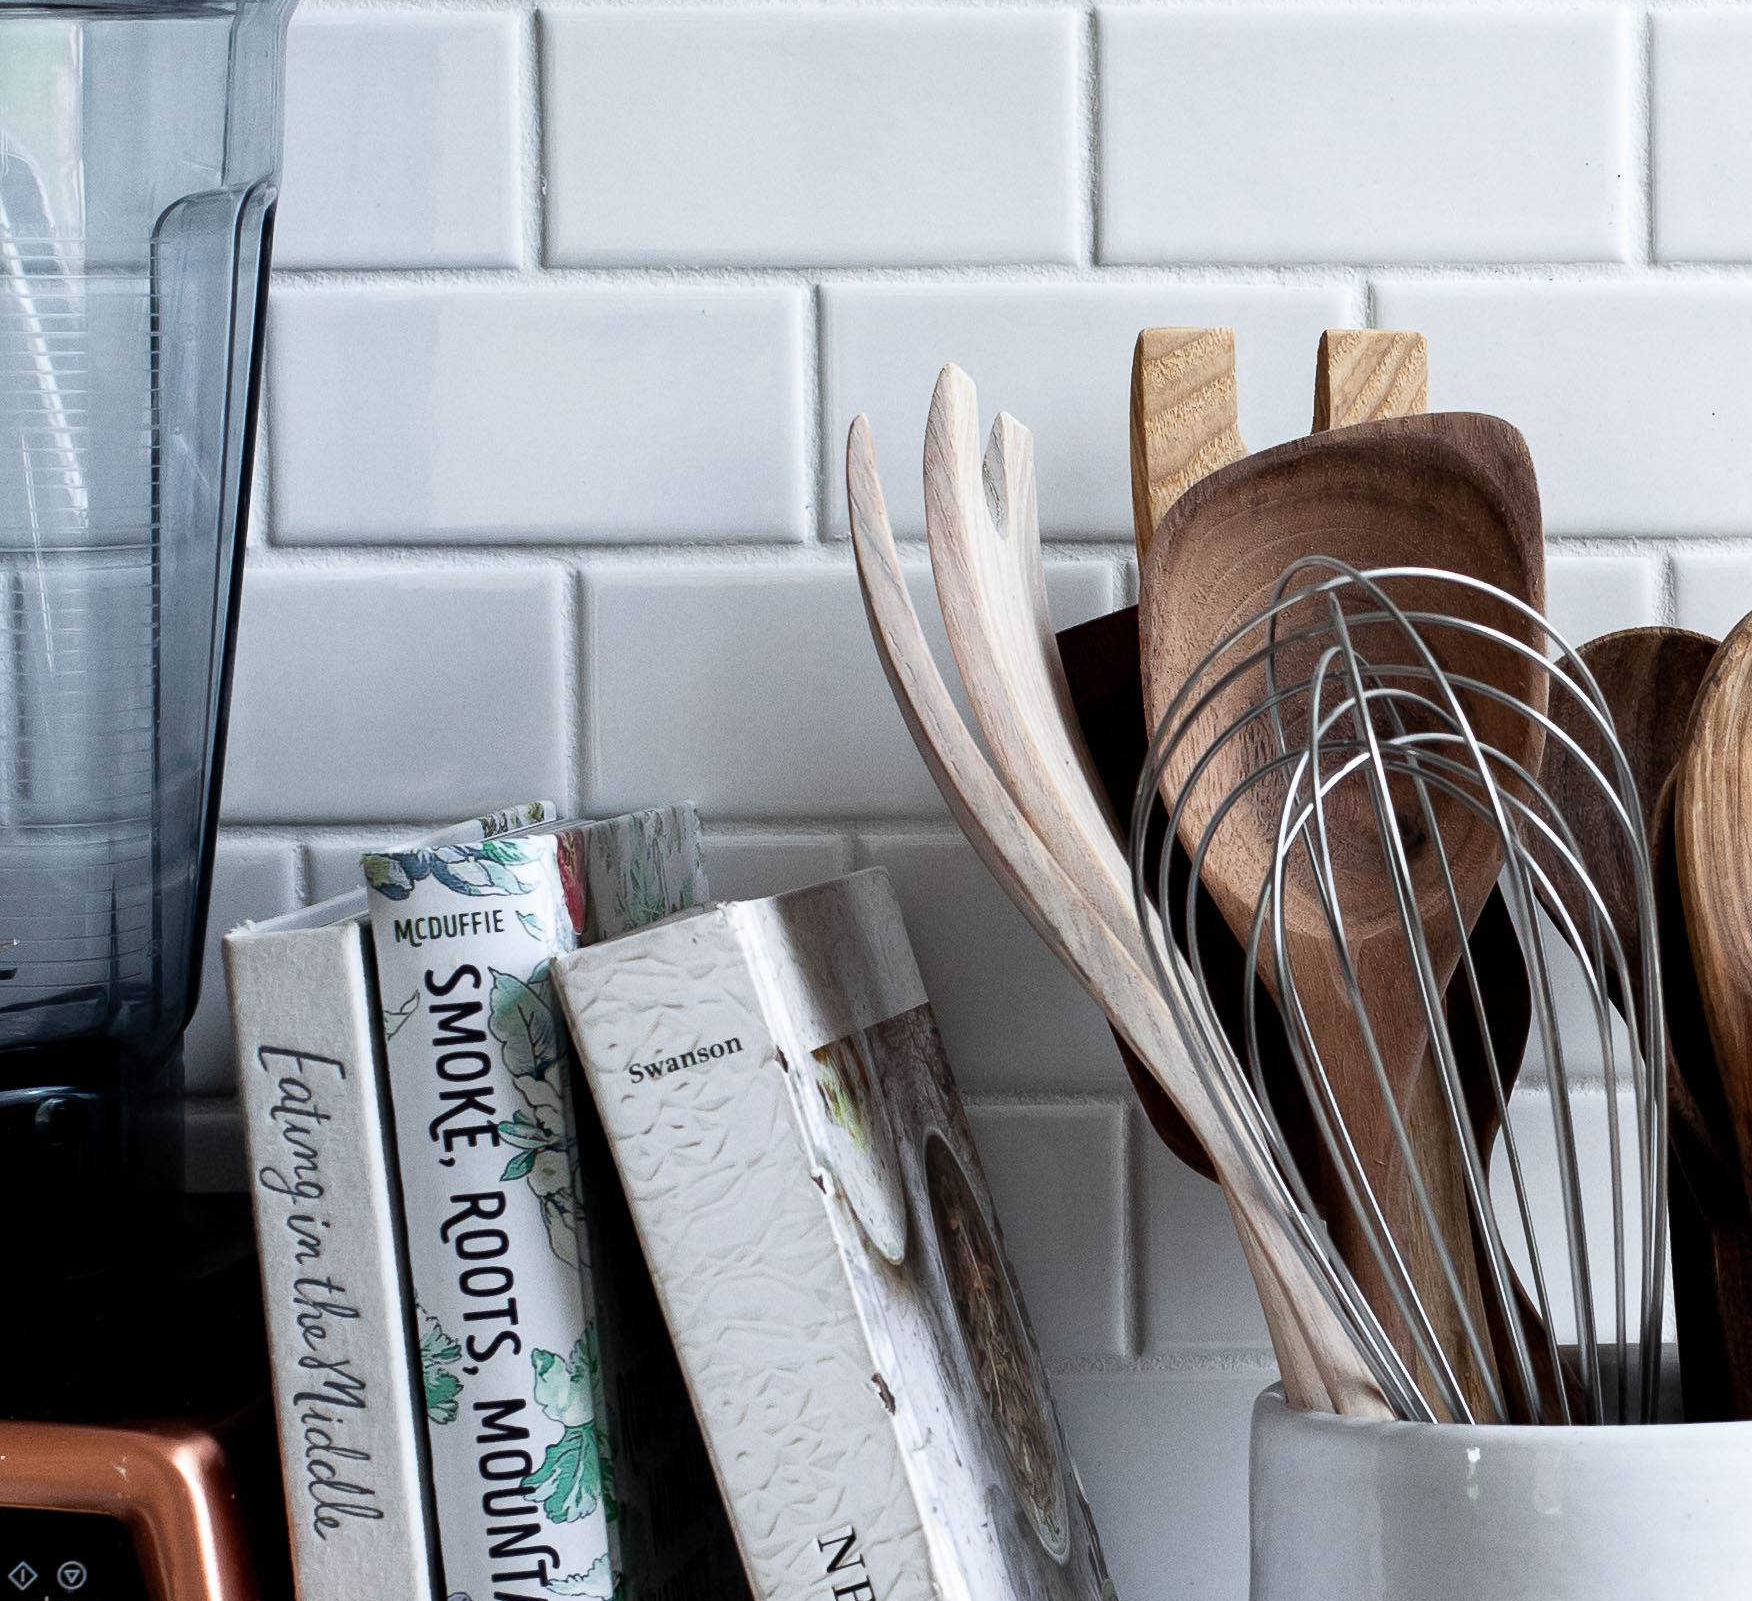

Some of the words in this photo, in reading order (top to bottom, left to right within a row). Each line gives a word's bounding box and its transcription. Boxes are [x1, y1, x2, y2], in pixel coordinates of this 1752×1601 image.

[394, 909, 504, 947] MCDUFFIE
[424, 964, 501, 1167] SMOKE,
[628, 1037, 743, 1084] Swanson
[258, 1045, 346, 1205] Eating
[286, 1214, 331, 1265] in
[440, 1190, 522, 1375] ROOTS,
[293, 1277, 361, 1351] the
[293, 1355, 384, 1541] Middle
